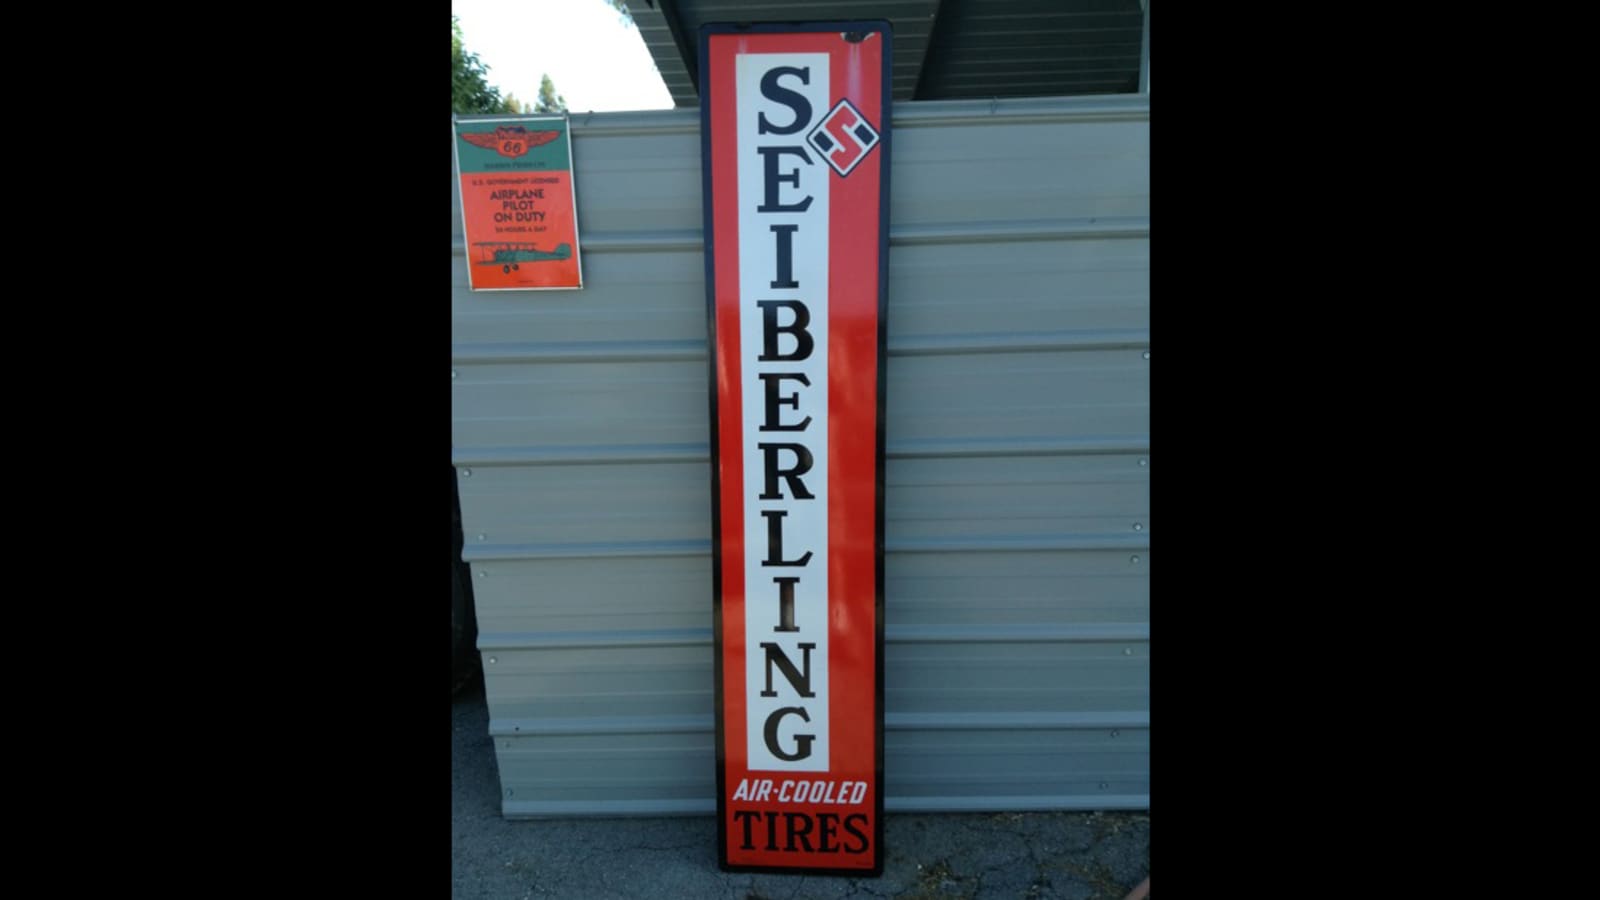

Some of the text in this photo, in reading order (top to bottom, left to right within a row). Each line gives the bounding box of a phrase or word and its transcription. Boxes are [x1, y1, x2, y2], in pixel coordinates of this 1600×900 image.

[503, 141, 523, 154] 66
[490, 189, 545, 200] AIRPLANE
[502, 201, 535, 211] PILOT
[493, 211, 546, 223] ON DUTY
[757, 66, 817, 762] SEIBERLING
[733, 810, 870, 854] TIRES
